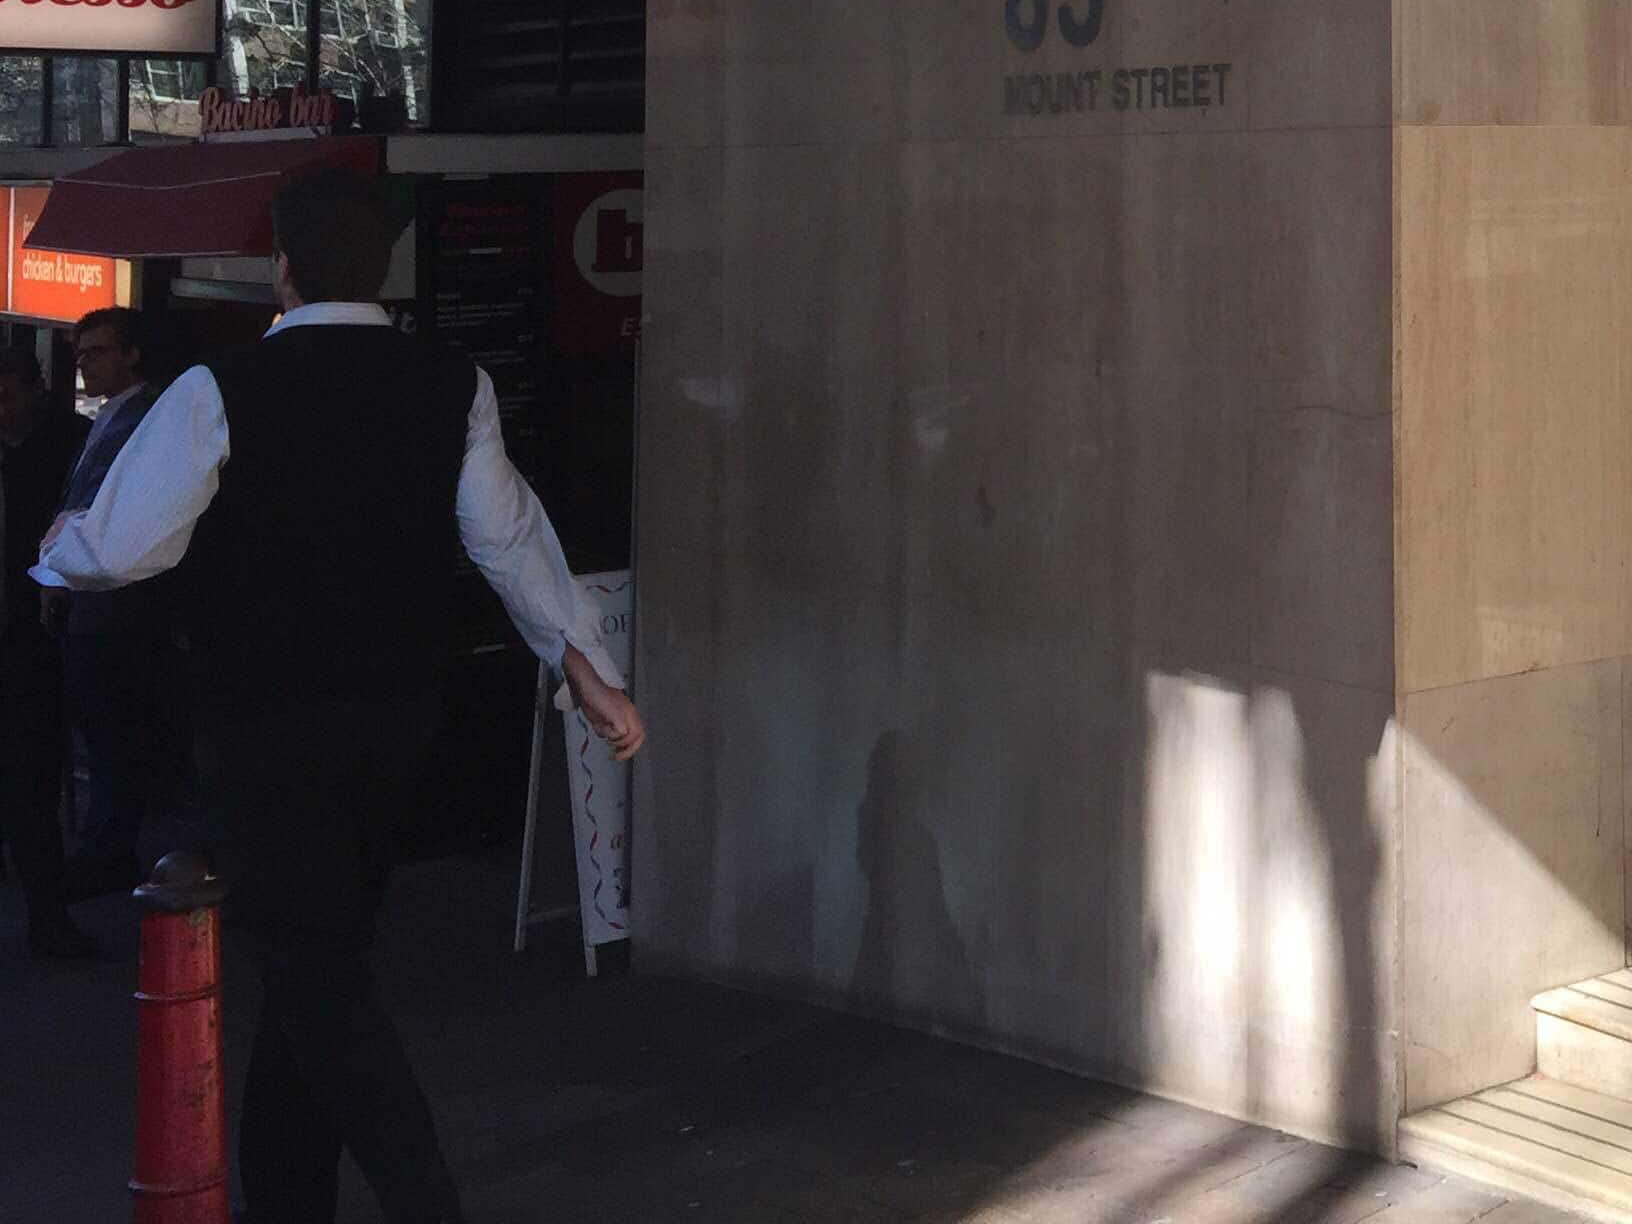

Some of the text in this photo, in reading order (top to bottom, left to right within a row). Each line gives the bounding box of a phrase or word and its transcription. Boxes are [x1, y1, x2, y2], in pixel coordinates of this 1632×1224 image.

[1004, 63, 1232, 117] MOUNT STREET
[22, 252, 54, 281] chicken
[64, 256, 103, 294] burgers
